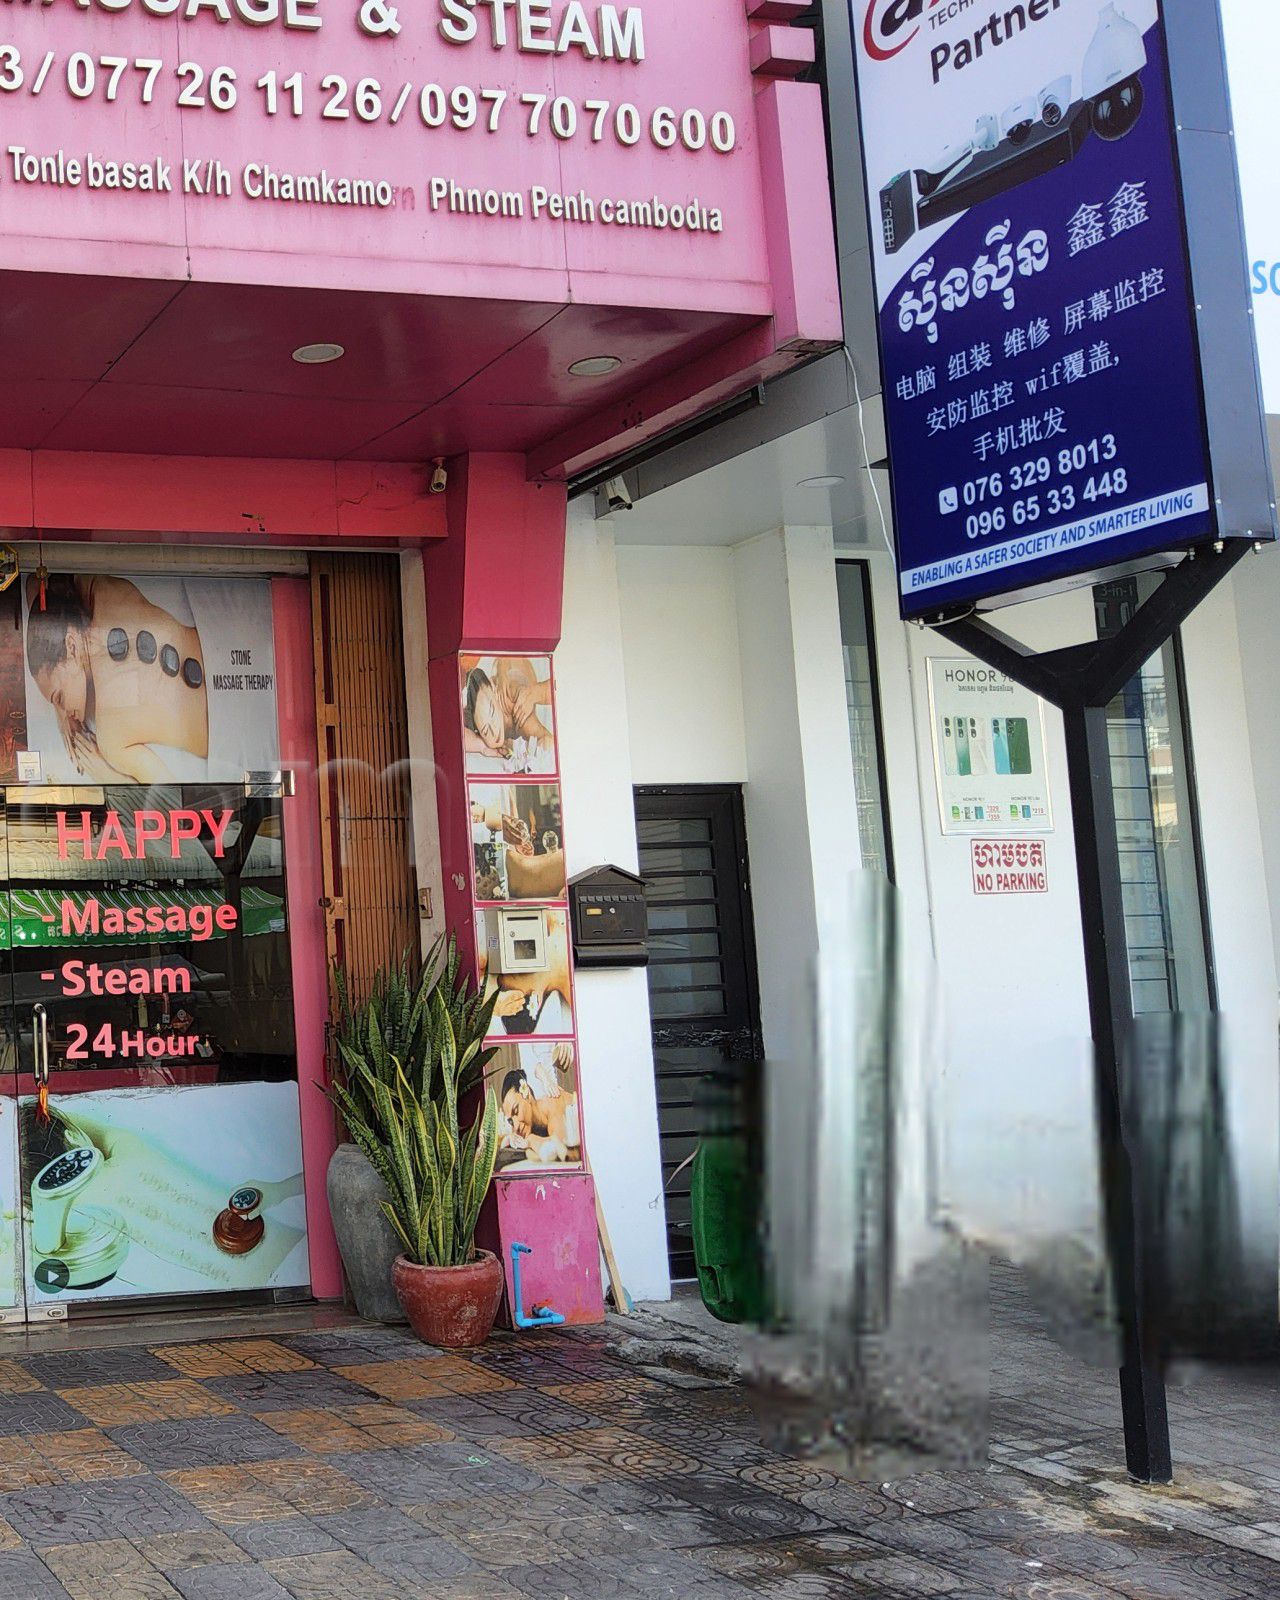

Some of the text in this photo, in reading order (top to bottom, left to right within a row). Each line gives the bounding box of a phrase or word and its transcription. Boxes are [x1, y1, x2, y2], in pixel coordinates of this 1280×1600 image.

[437, 0, 646, 63] STEAM
[176, 61, 238, 111] 26
[257, 70, 303, 117] 11
[650, 106, 737, 153] 600
[183, 157, 232, 197] K/h
[430, 176, 524, 218] Phnom
[530, 185, 596, 224] Penh
[600, 193, 724, 234] cambodia
[1065, 180, 1150, 257] 鑫鑫
[895, 267, 1167, 401] 电脑 组装 维修 屏幕监控
[926, 380, 1016, 437] 安防监控
[972, 406, 1068, 462] 手机批发
[963, 433, 1118, 506] 076 329 8013
[966, 467, 1129, 539] 096 65 33 448
[911, 491, 1194, 588] ENABLING A SAFER SOCIETY AND SMARTER LIVING
[212, 674, 273, 691] MASSAGE THERAPY
[230, 649, 252, 666] STONE
[944, 669, 997, 683] HONOR
[55, 809, 236, 860] HAPPY
[976, 872, 1046, 892] NO PARKING
